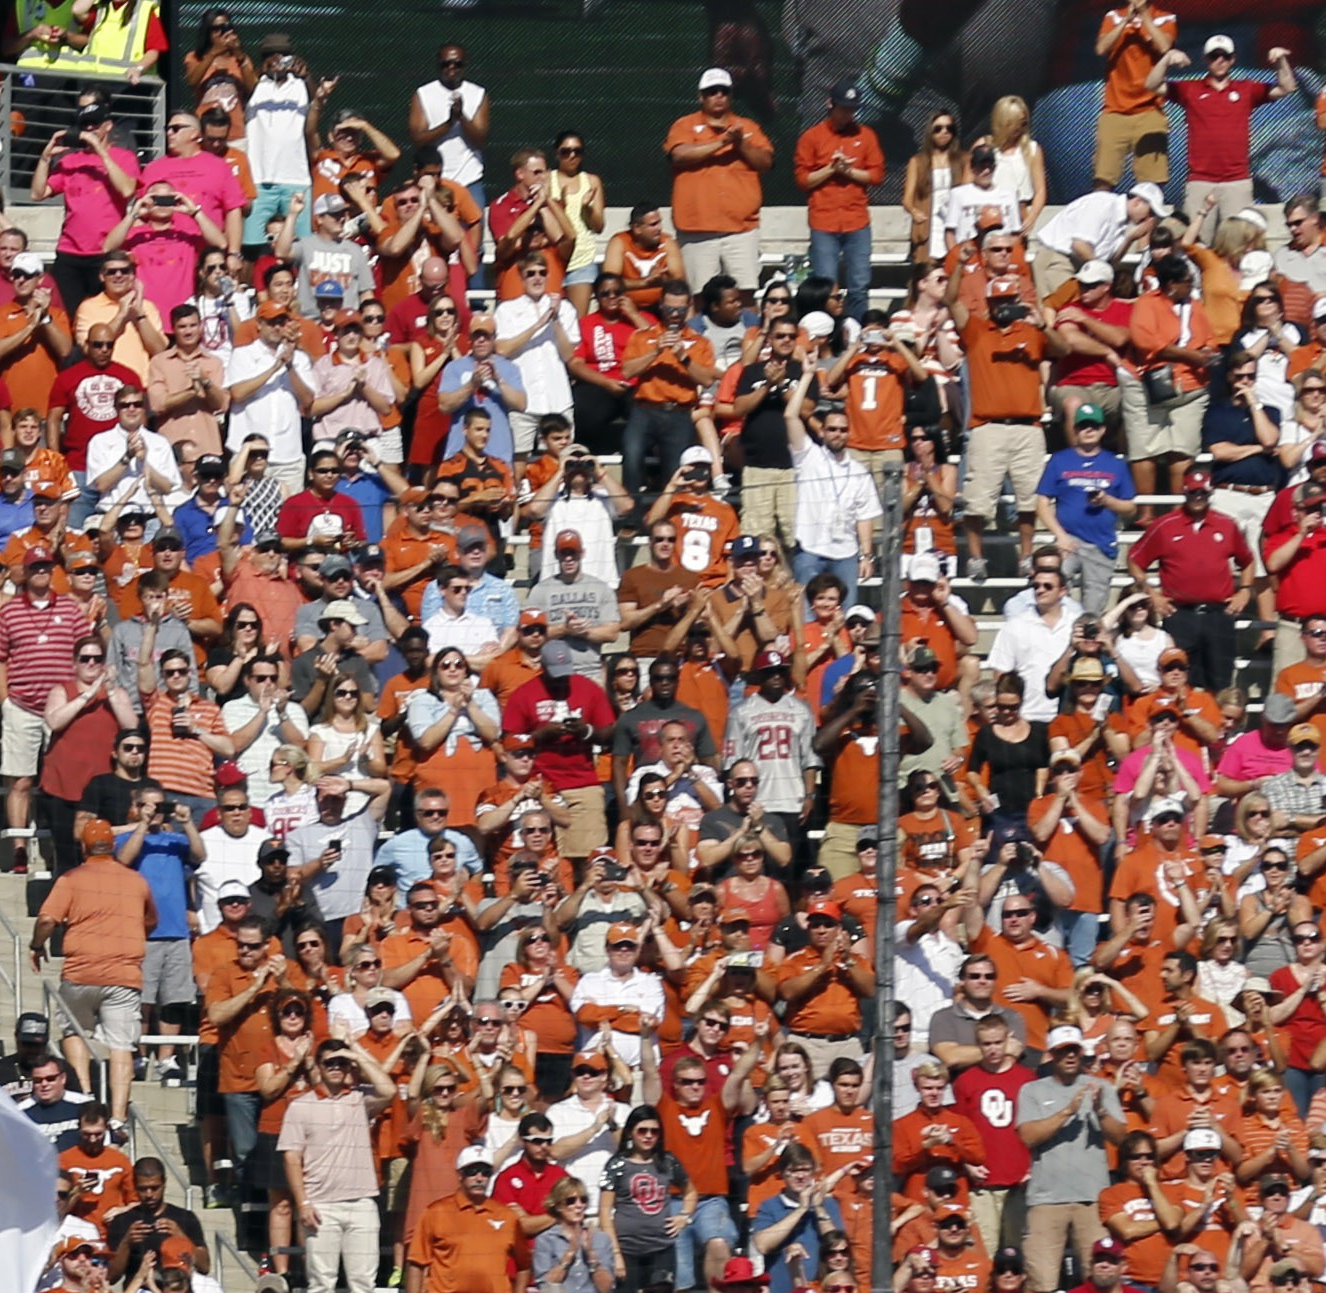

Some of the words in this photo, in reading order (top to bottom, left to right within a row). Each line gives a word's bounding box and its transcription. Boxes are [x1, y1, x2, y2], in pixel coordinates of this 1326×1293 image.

[309, 250, 352, 274] JUST
[861, 377, 879, 410] 1
[681, 513, 718, 532] TEXAS
[681, 530, 711, 571] 8
[550, 592, 596, 605] DALLAS
[757, 726, 792, 759] 28
[981, 1089, 1013, 1127] OU
[818, 1132, 874, 1147] TEXAS
[629, 1174, 665, 1215] OU
